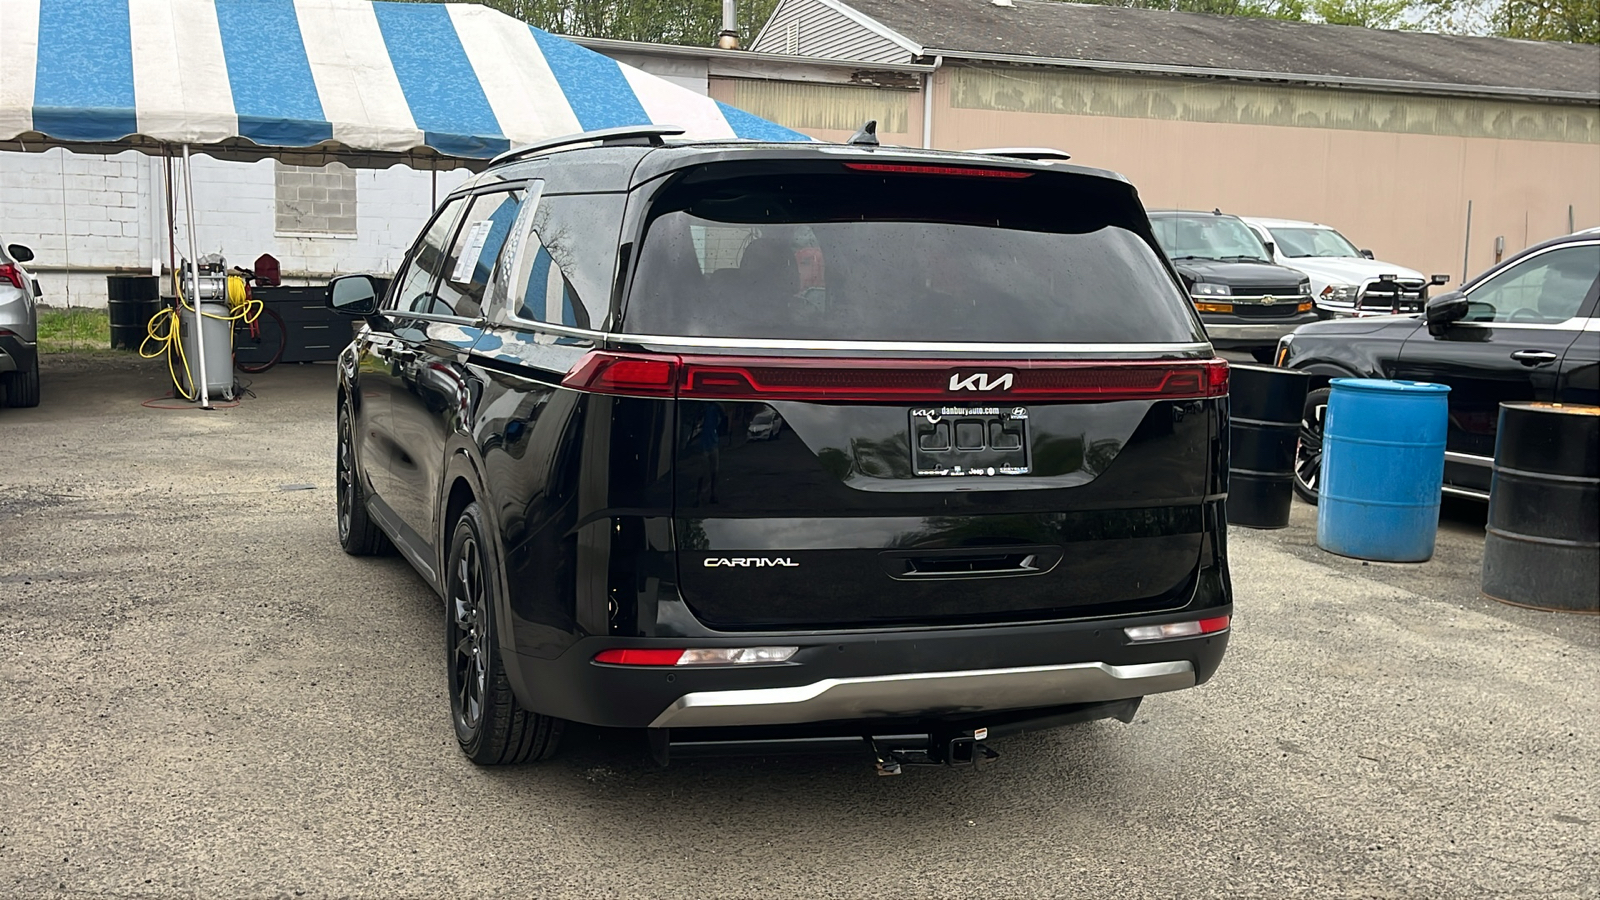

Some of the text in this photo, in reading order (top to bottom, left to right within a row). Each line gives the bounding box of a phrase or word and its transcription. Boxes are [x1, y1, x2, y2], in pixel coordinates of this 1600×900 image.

[949, 373, 1013, 391] KIA
[941, 406, 1000, 416] danburyauto.com
[704, 558, 799, 567] CARNIVAL
